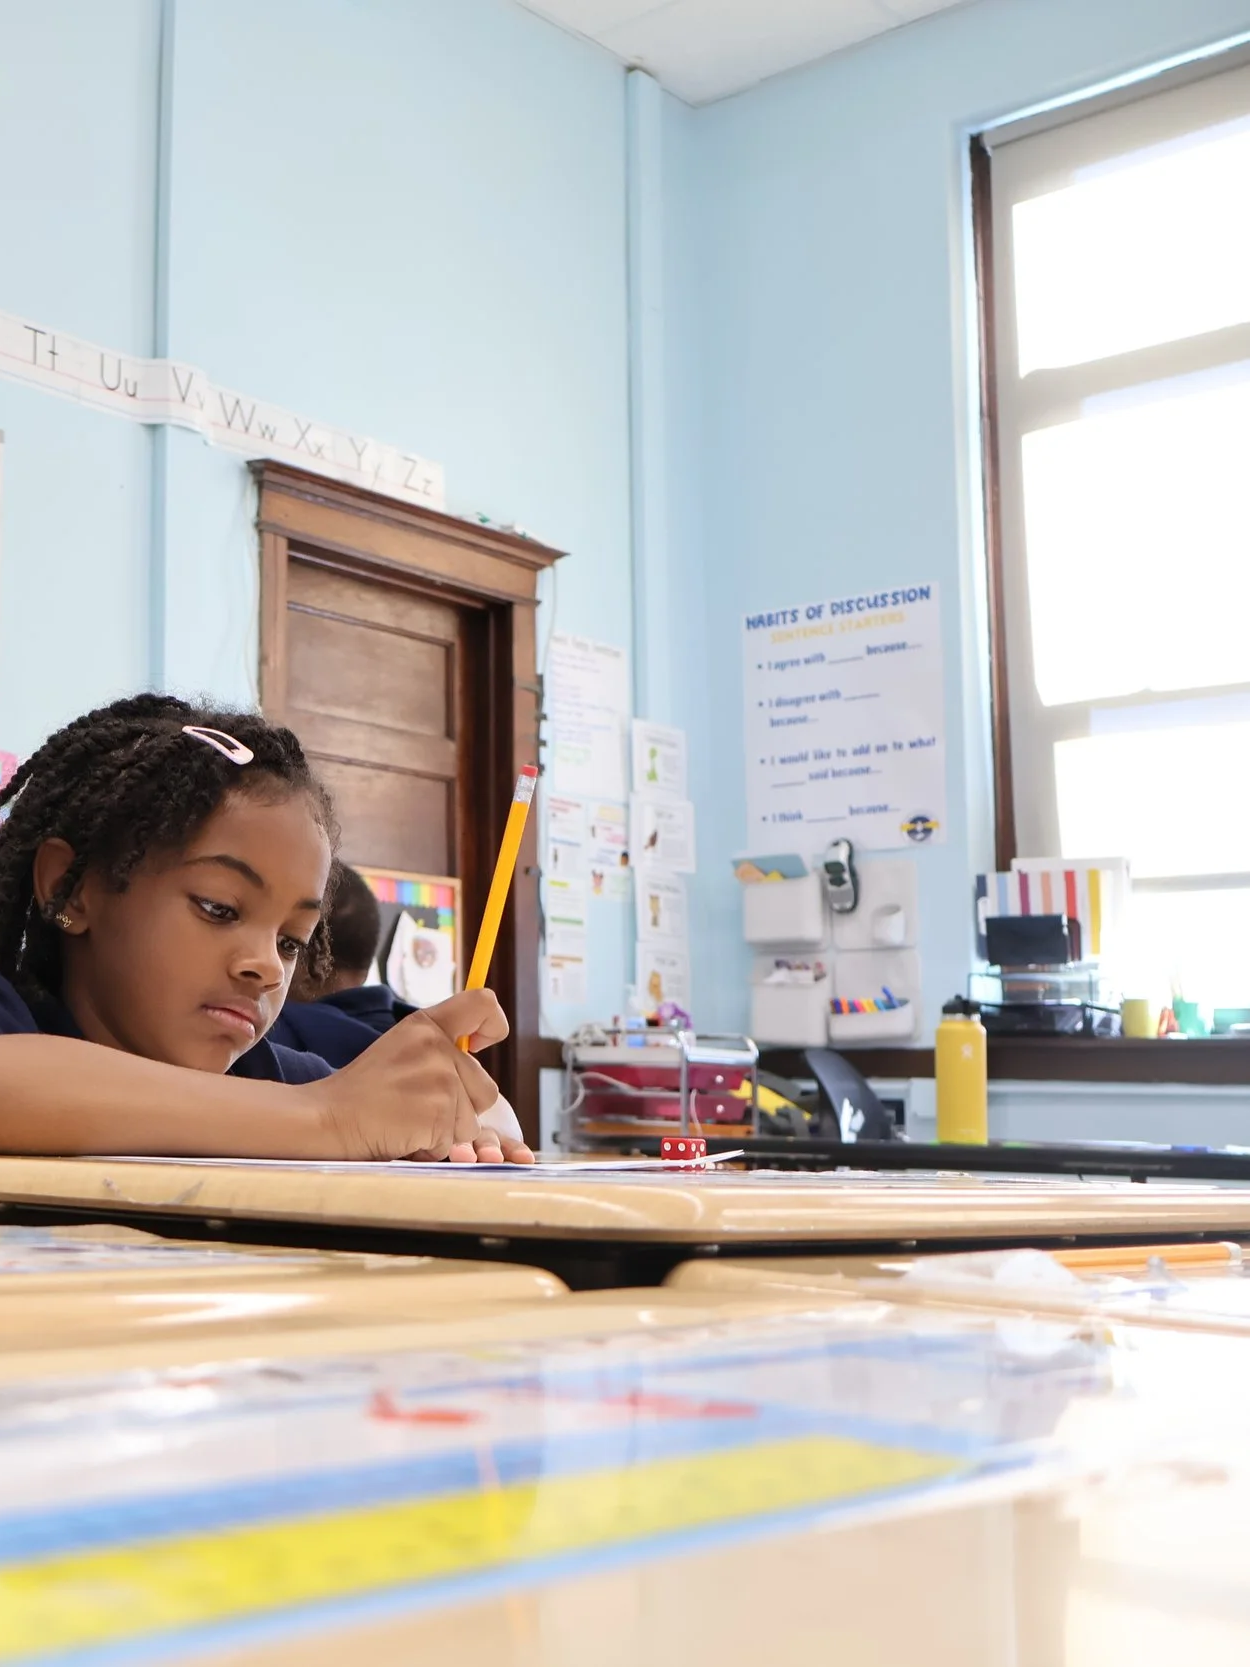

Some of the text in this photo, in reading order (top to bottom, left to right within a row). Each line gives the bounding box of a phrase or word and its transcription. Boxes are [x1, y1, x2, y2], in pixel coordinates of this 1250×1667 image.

[23, 324, 59, 371] Tt
[99, 353, 138, 399] Uu
[218, 392, 277, 441] Ww
[293, 416, 325, 458] Xx
[348, 436, 381, 488] Yy
[402, 455, 433, 496] Zz
[746, 585, 931, 630] HABITS OF DISCUSSION
[770, 611, 906, 644] SENTENCE STARTERS
[774, 658, 801, 671] agree
[803, 653, 826, 665] with
